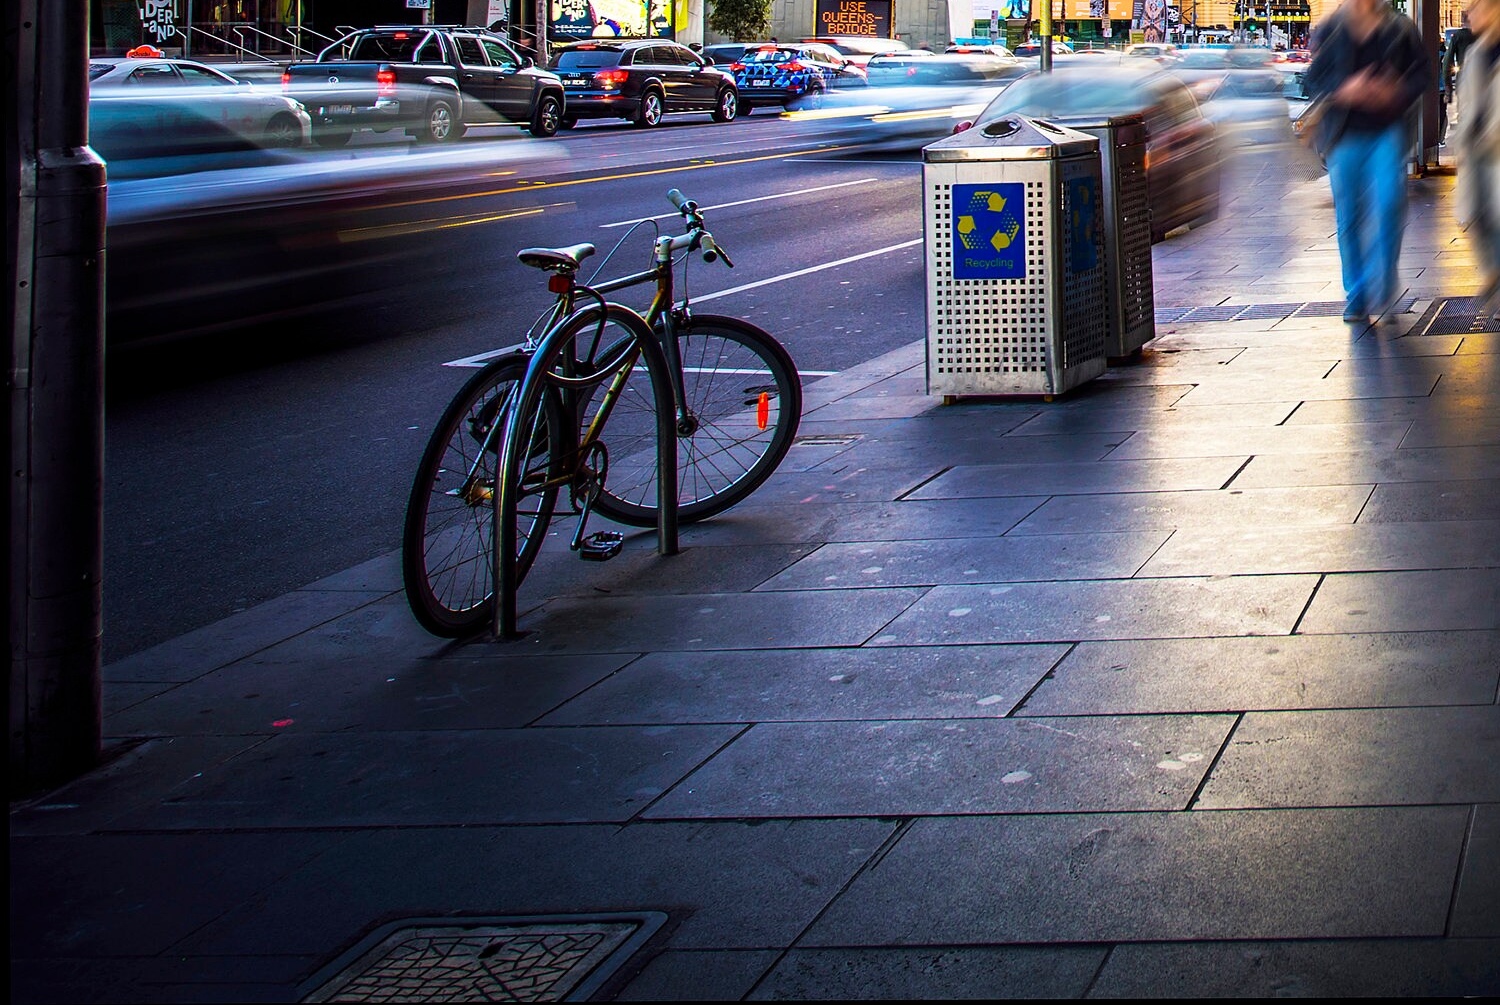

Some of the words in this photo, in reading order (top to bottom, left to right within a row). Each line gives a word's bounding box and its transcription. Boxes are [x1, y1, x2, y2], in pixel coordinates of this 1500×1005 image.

[840, 1, 867, 12] USE
[822, 12, 883, 23] QUEENS-
[827, 23, 877, 34] BRIDGE
[964, 258, 1014, 269] Recycling
